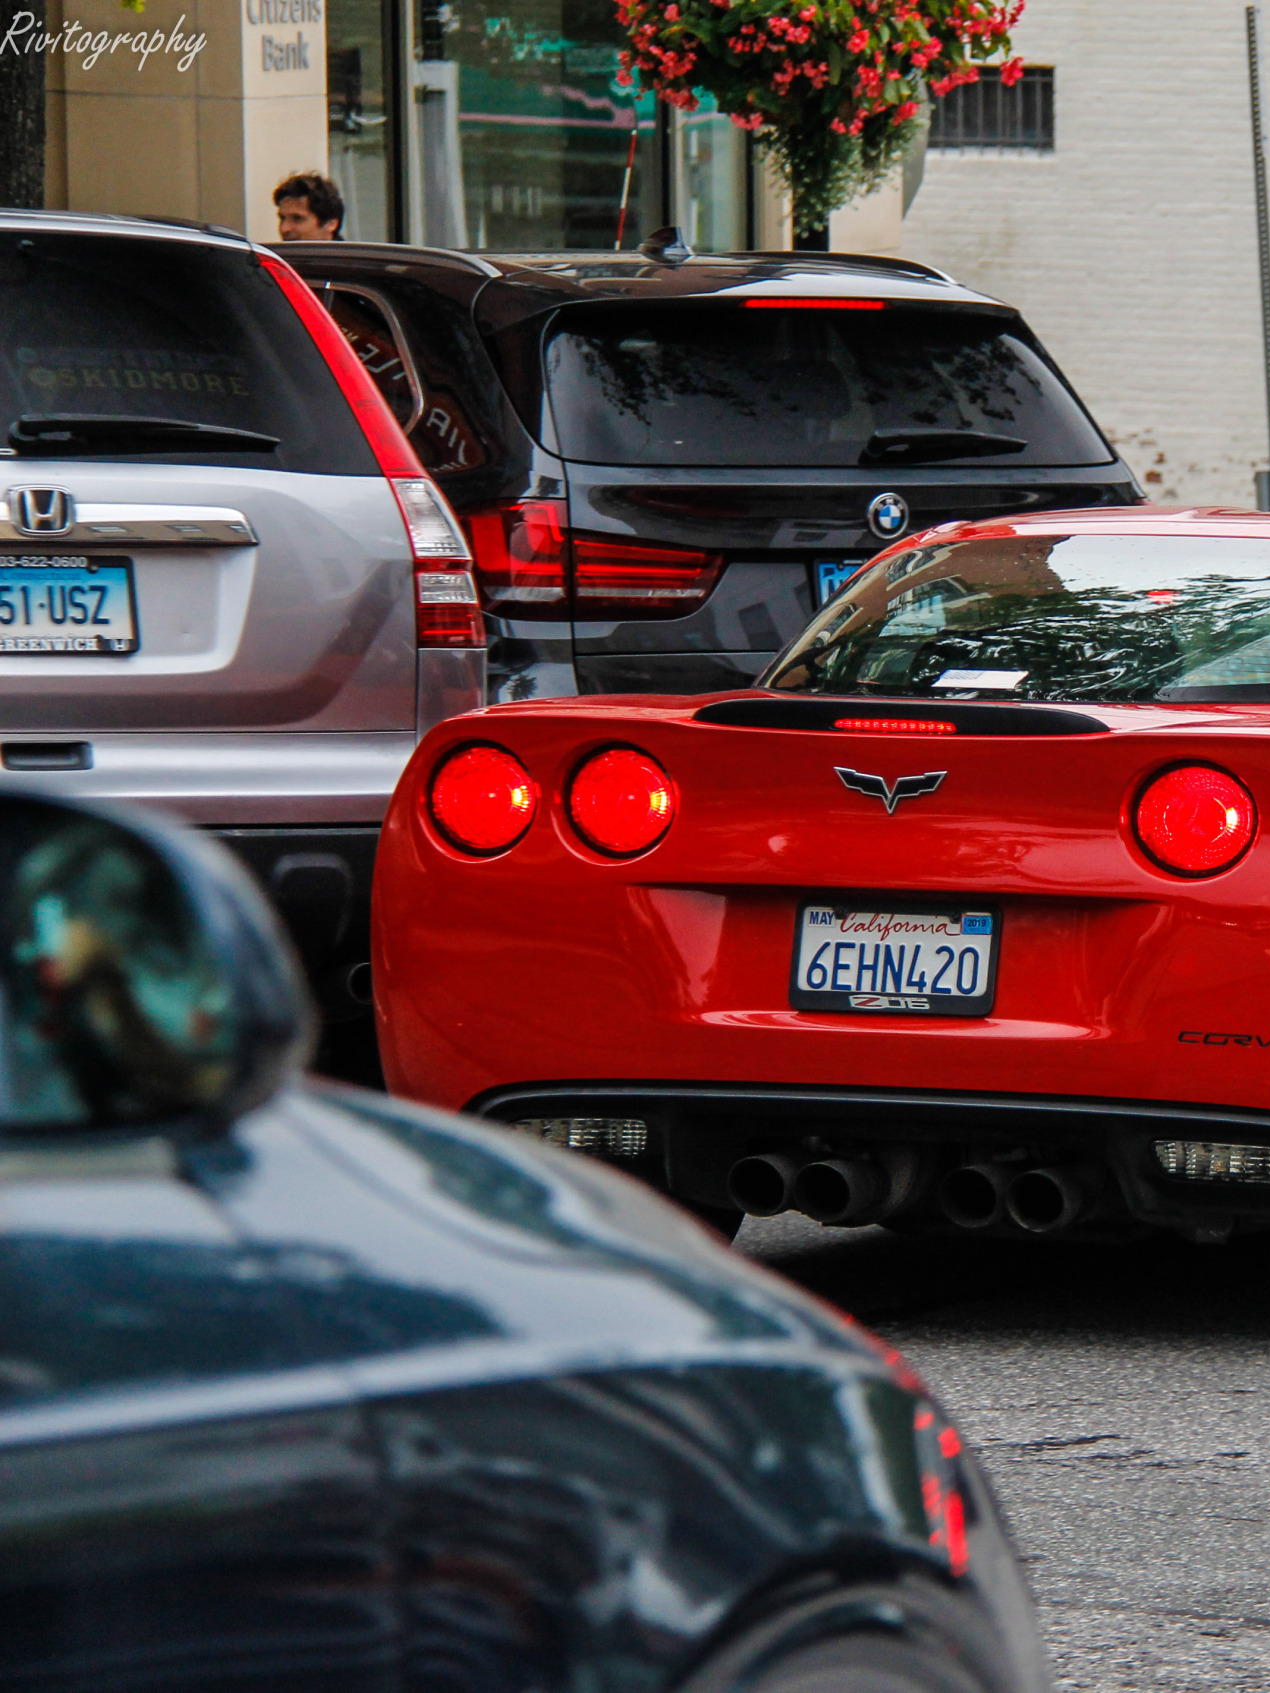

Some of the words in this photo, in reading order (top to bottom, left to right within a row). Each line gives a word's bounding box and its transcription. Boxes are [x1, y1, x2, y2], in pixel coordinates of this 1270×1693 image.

[262, 31, 309, 72] Bank
[54, 367, 249, 397] SKIDMORE
[809, 911, 834, 925] MAY
[840, 912, 961, 942] California
[967, 918, 987, 928] 2019
[806, 941, 980, 995] 6EHN420
